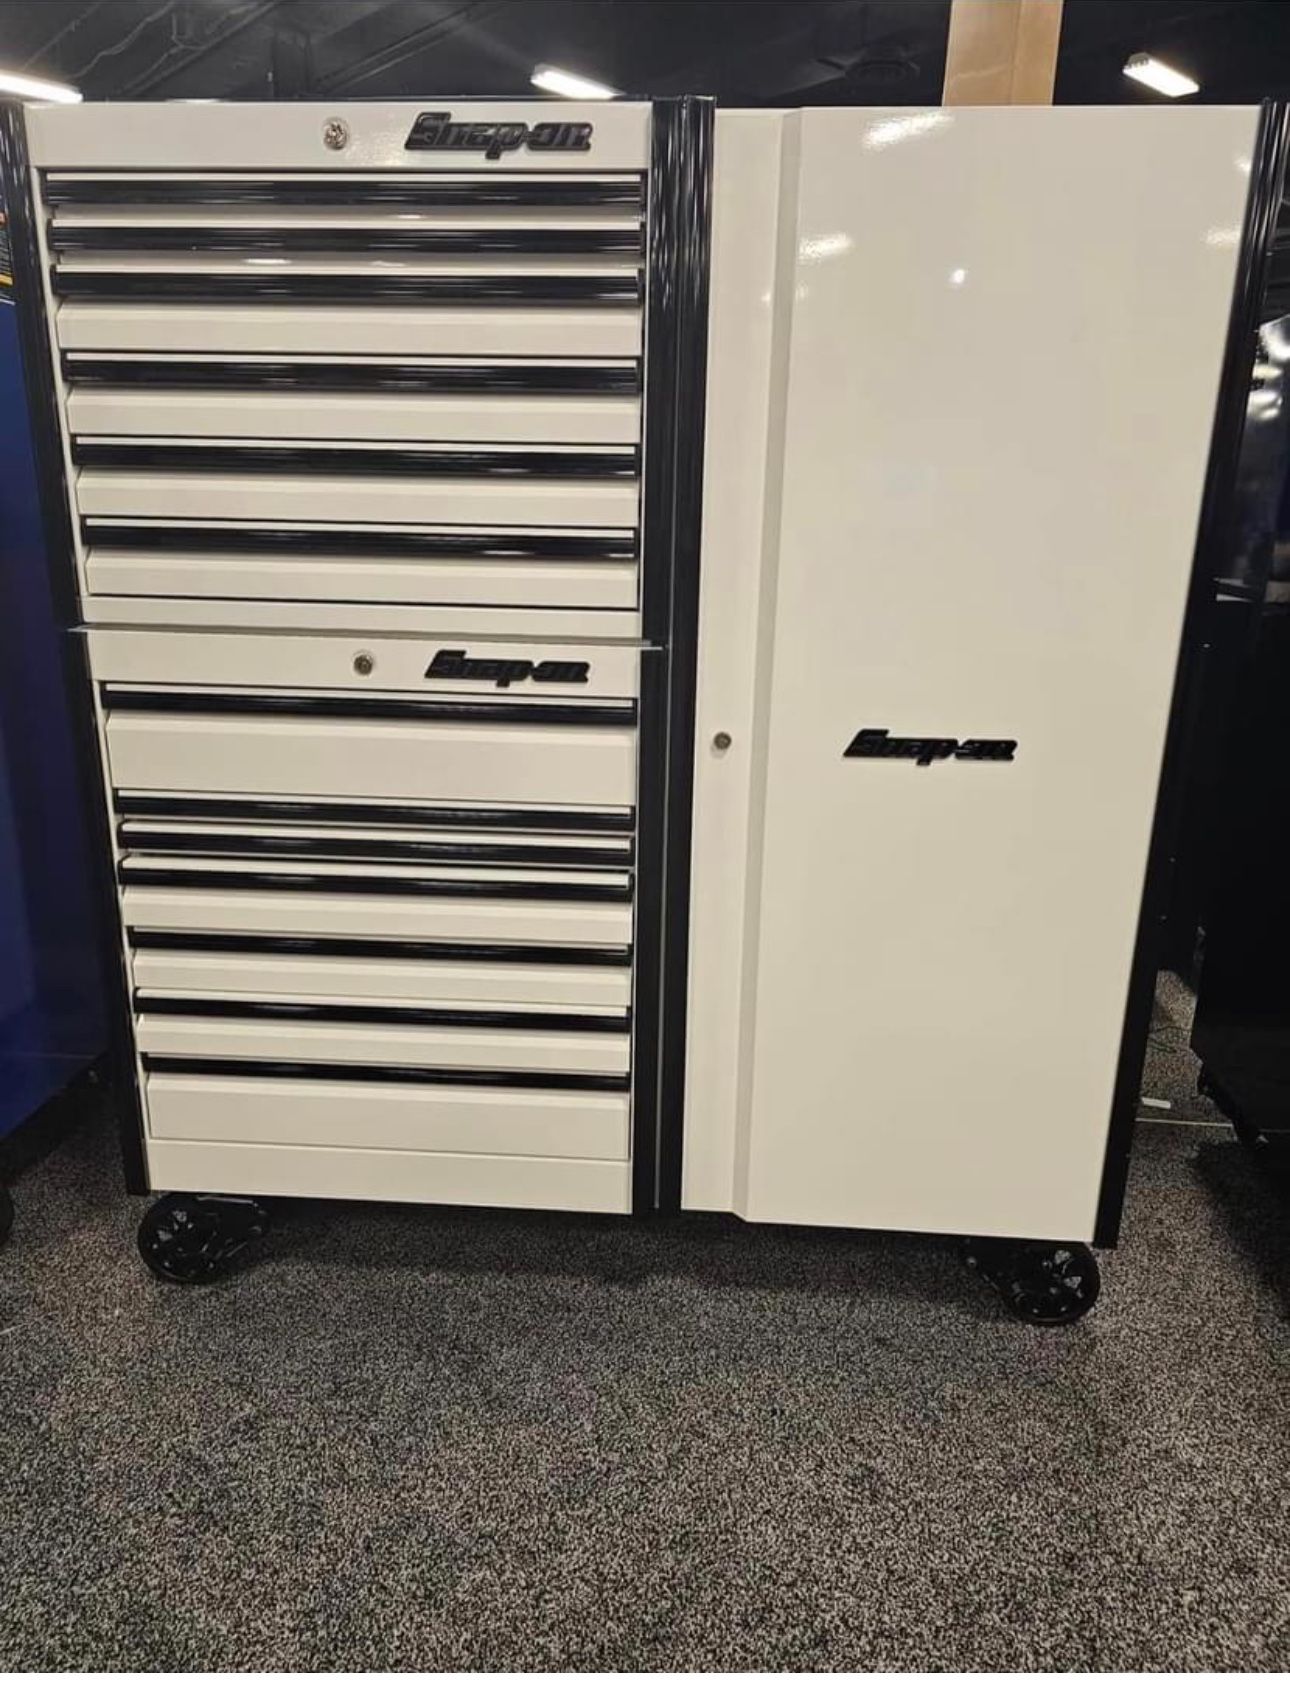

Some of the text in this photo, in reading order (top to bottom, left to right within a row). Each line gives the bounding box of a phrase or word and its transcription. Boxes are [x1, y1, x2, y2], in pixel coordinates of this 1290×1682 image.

[404, 111, 593, 159] Snap-on
[424, 649, 590, 687] Snap-on
[843, 728, 1018, 766] Snap-on
